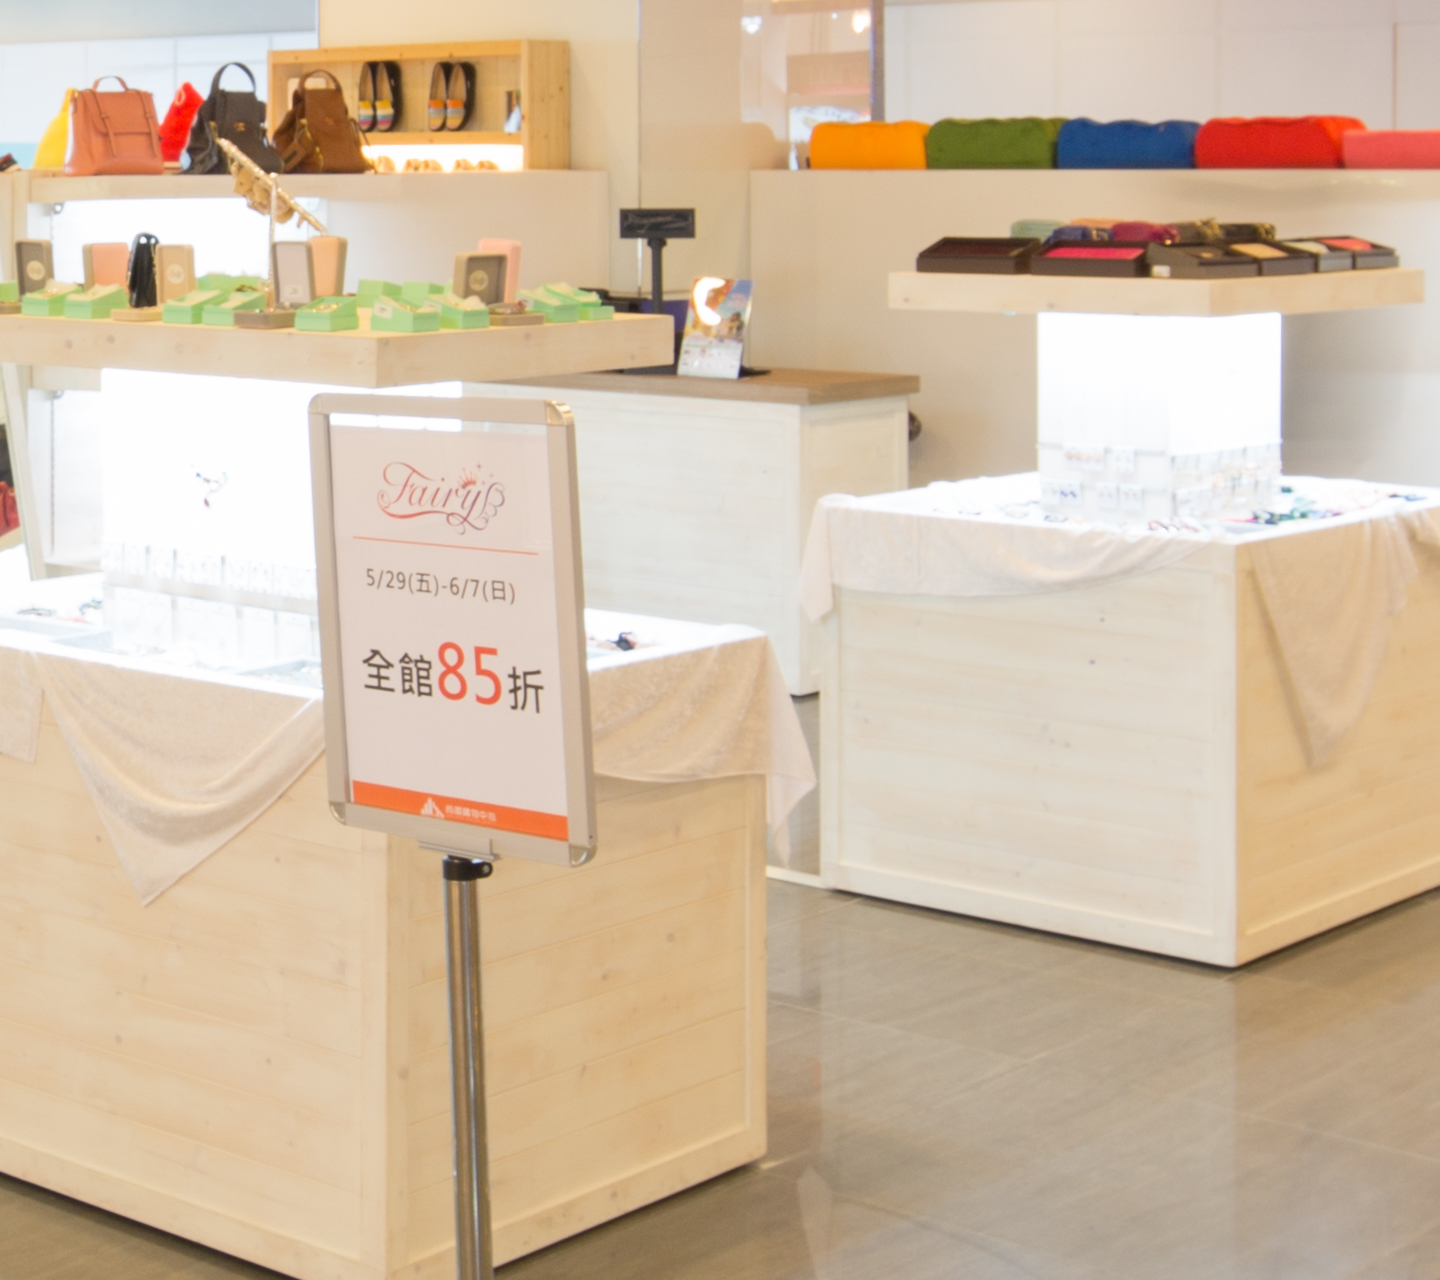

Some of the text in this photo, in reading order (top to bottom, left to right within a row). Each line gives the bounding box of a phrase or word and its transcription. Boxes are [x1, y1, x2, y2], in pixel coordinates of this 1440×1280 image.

[376, 461, 505, 535] Fairy
[365, 567, 517, 606] 5/29(五)-6/7(日)
[361, 640, 545, 715] 全館85折
